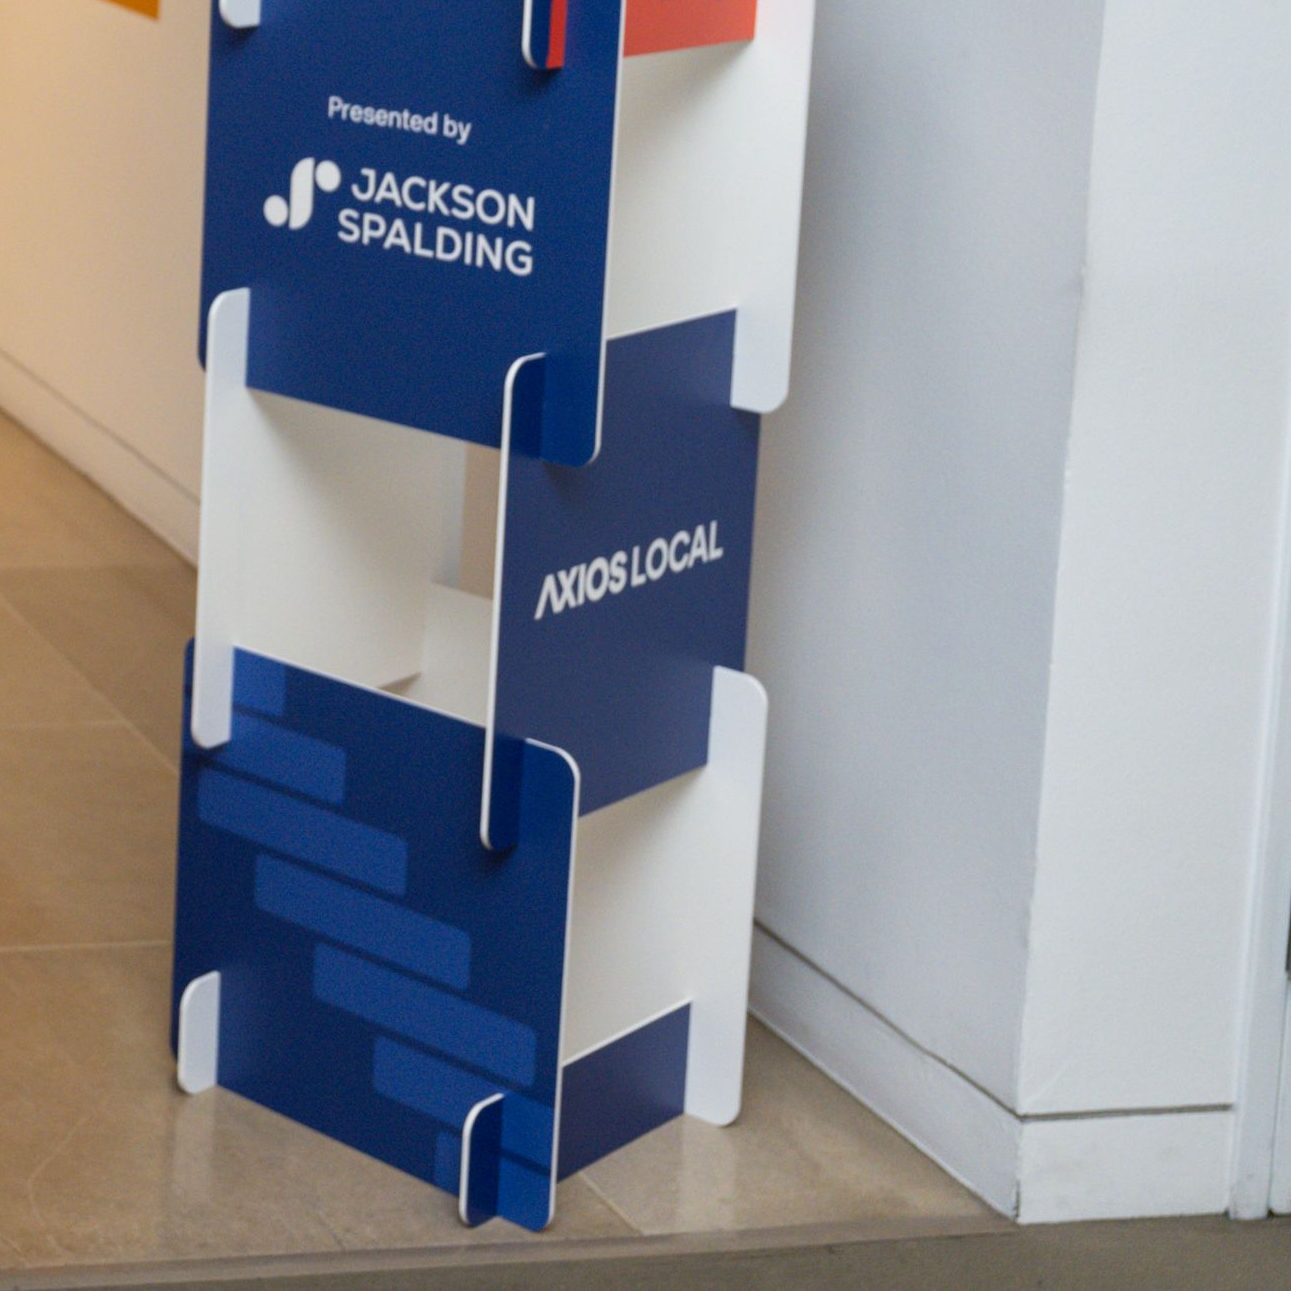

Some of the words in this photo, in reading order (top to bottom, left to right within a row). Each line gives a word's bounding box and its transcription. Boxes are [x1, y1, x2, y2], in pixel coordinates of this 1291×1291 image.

[328, 96, 438, 135] Presented
[444, 114, 471, 144] by
[351, 168, 535, 230] JACKSON
[338, 210, 533, 276] SPALDING
[534, 551, 627, 620] AXIOS
[630, 520, 723, 587] LOCAL
